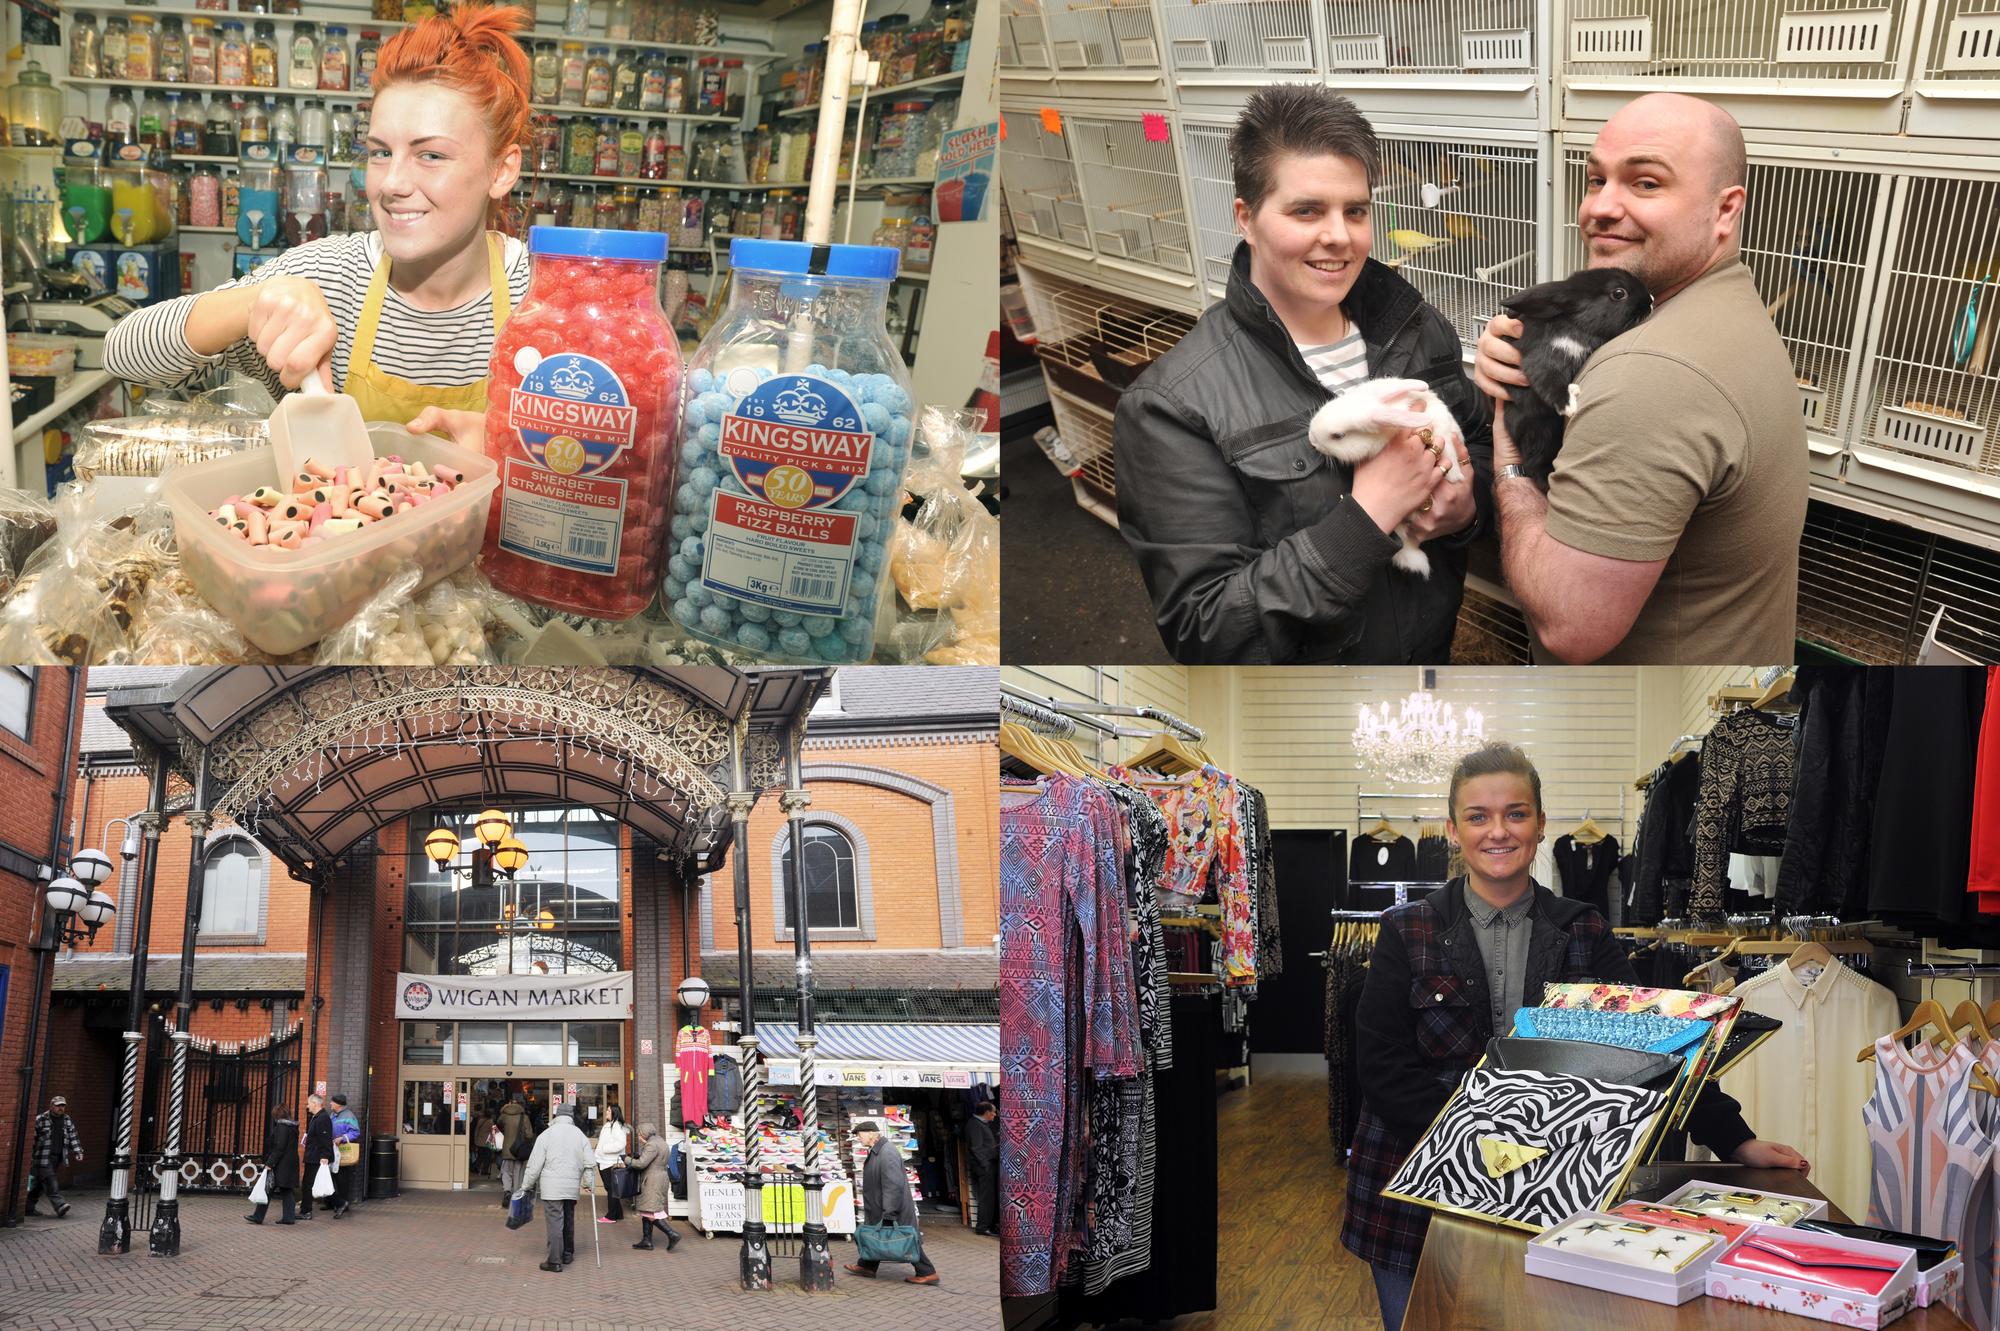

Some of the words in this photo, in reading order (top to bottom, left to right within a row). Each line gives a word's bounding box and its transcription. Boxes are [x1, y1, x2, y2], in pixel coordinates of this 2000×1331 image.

[948, 125, 987, 148] SLUSH
[969, 134, 996, 153] HERE
[530, 380, 544, 392] 19
[599, 392, 619, 404] 62
[513, 394, 631, 430] KINGSWAY
[746, 404, 765, 417] 19
[512, 418, 556, 434] QUALITY
[562, 428, 590, 440] PICK
[608, 435, 628, 444] MIX
[832, 417, 856, 429] 62
[725, 418, 869, 458] KINGSWAY
[549, 439, 579, 460] 50
[723, 446, 780, 462] QUALITY
[786, 457, 818, 470] PICK
[841, 465, 865, 474] MIX
[531, 471, 595, 491] SHERBET
[767, 469, 808, 492] 50
[511, 477, 617, 506] STRAWBERRIES
[735, 501, 836, 528] RASPBERRY
[737, 514, 772, 532] FIZZ
[775, 523, 830, 540] BALLS
[757, 533, 775, 542] FRUIT
[775, 537, 806, 547] FLAVOUR
[764, 541, 788, 550] BOILED
[789, 545, 815, 554] SWEETS
[750, 579, 767, 593] 3Kg
[438, 988, 518, 1006] WIGAN
[528, 987, 624, 1006] MARKET
[843, 1072, 867, 1082] VANS
[919, 1073, 942, 1083] VANS
[946, 1075, 966, 1083] VANS
[715, 1211, 742, 1219] JEANS
